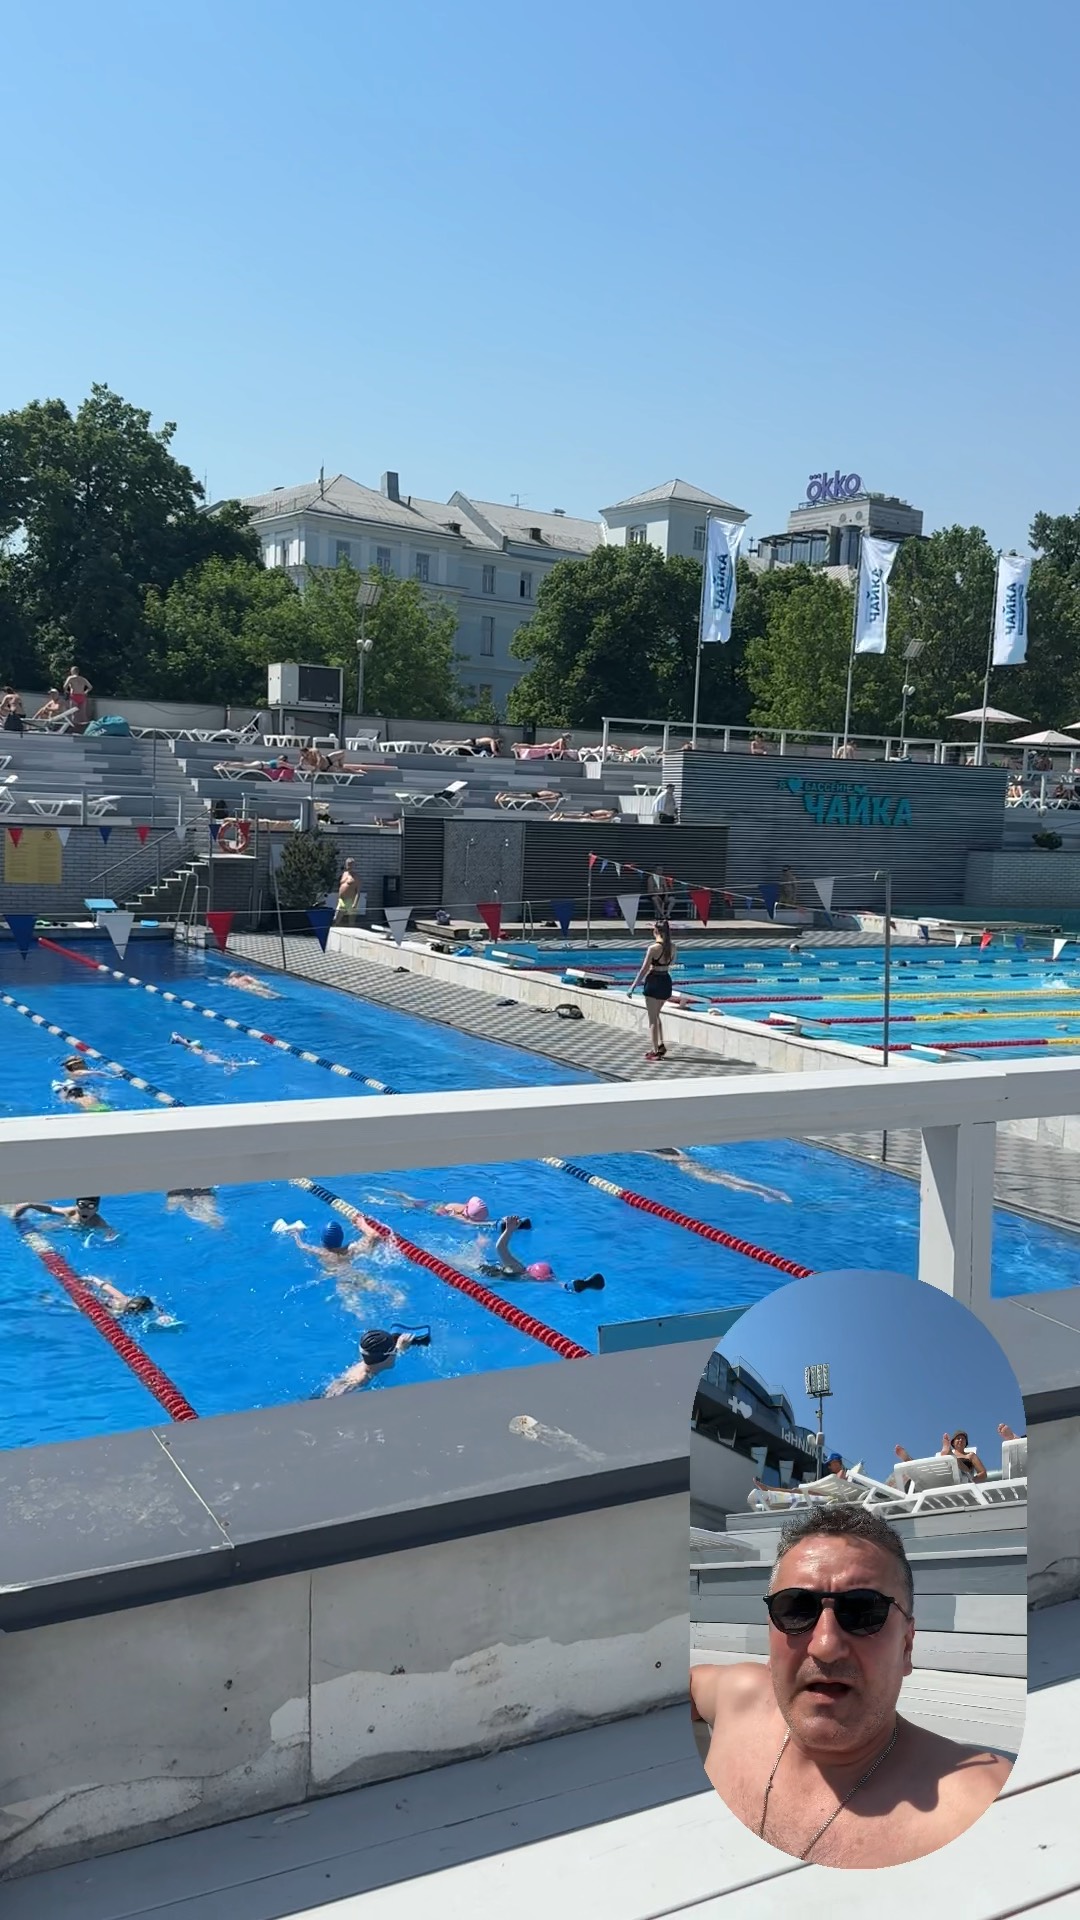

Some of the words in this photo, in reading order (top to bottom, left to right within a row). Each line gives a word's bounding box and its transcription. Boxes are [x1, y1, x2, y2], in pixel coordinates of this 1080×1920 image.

[712, 553, 728, 609] ЧАЙКА
[866, 568, 883, 623] ЧАЙКА
[1002, 582, 1016, 635] ЧАЙКА
[803, 786, 913, 826] ЧАЙКА
